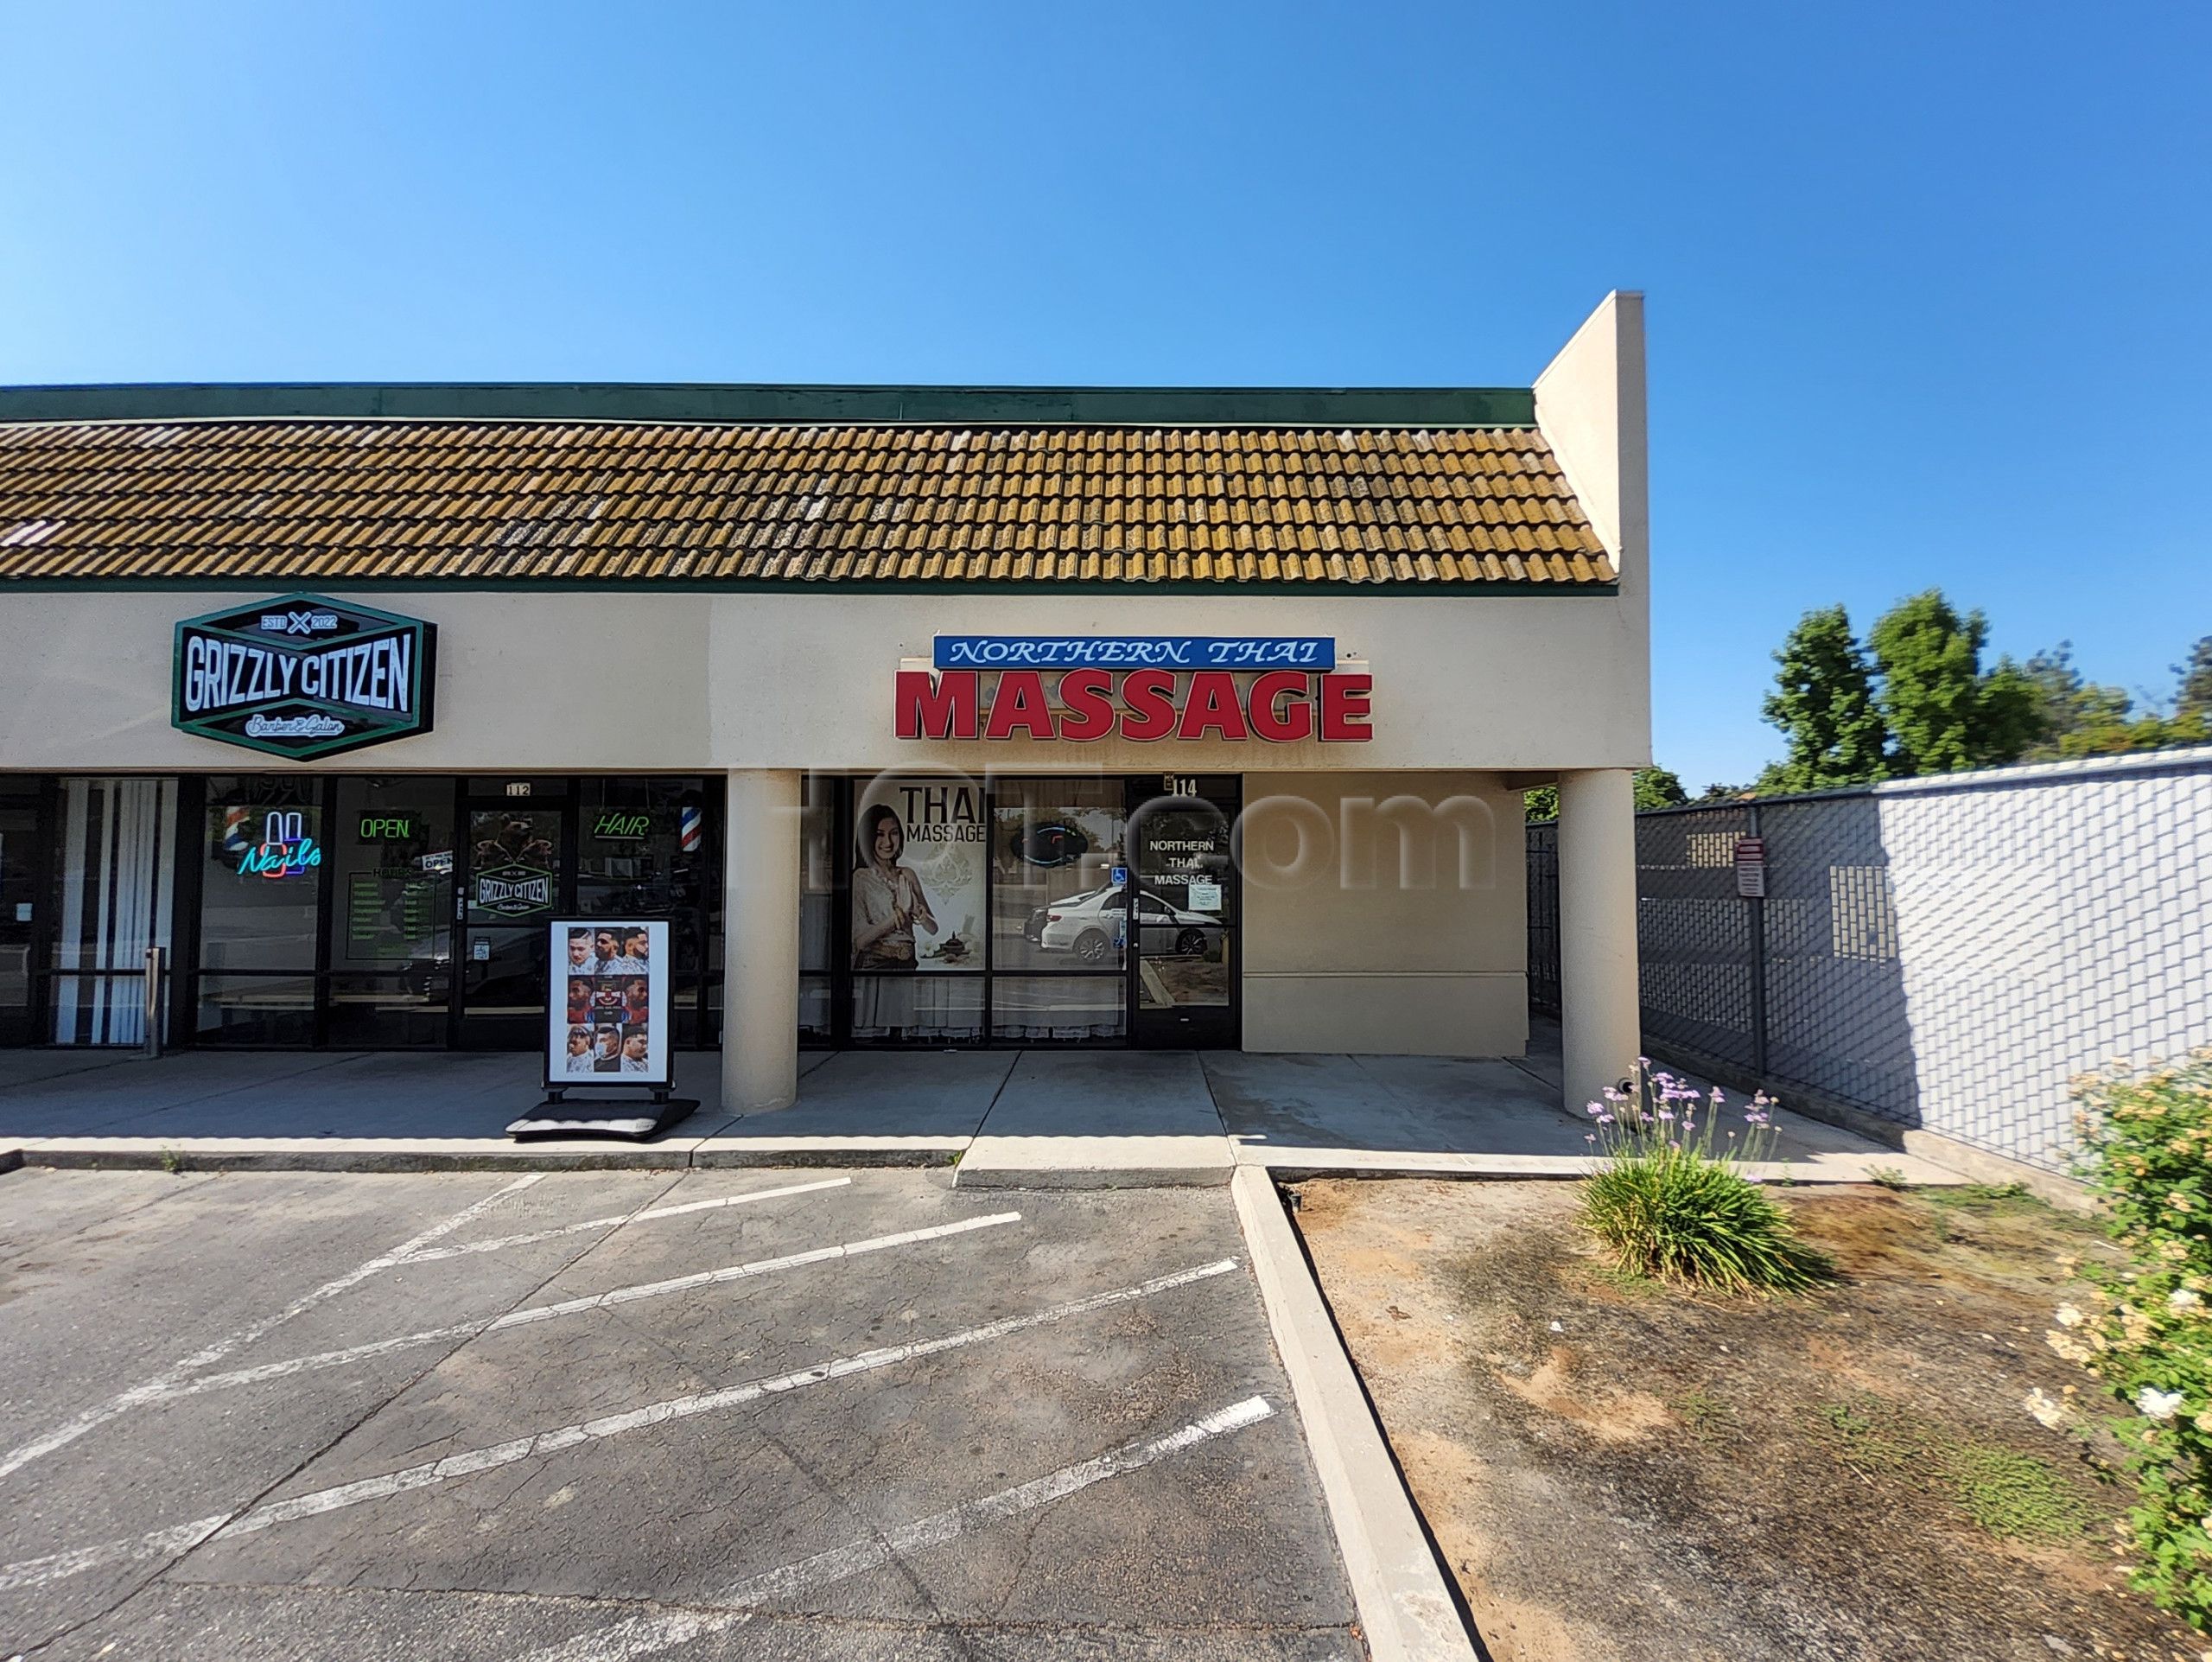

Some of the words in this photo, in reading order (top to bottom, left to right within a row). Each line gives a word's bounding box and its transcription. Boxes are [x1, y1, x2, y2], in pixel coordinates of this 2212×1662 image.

[311, 614, 337, 629] 2022
[950, 640, 1190, 664] NORTHERN
[1208, 640, 1319, 664] THAI
[185, 635, 297, 712] GRIZZLY
[301, 634, 411, 712] CITIZEN
[894, 668, 1373, 742] MASSAGE
[508, 785, 530, 796] 112
[1172, 779, 1198, 796] 114
[899, 786, 987, 824] THAI
[360, 818, 410, 839] OPEN
[594, 812, 649, 834] HAIR
[906, 825, 986, 843] MASSAGE
[237, 837, 322, 876] Nails
[1149, 840, 1214, 852] NORTHERN
[480, 877, 514, 904] GRIZZLY
[514, 876, 550, 904] CITIZEN
[1154, 874, 1213, 886] MASSAGE
